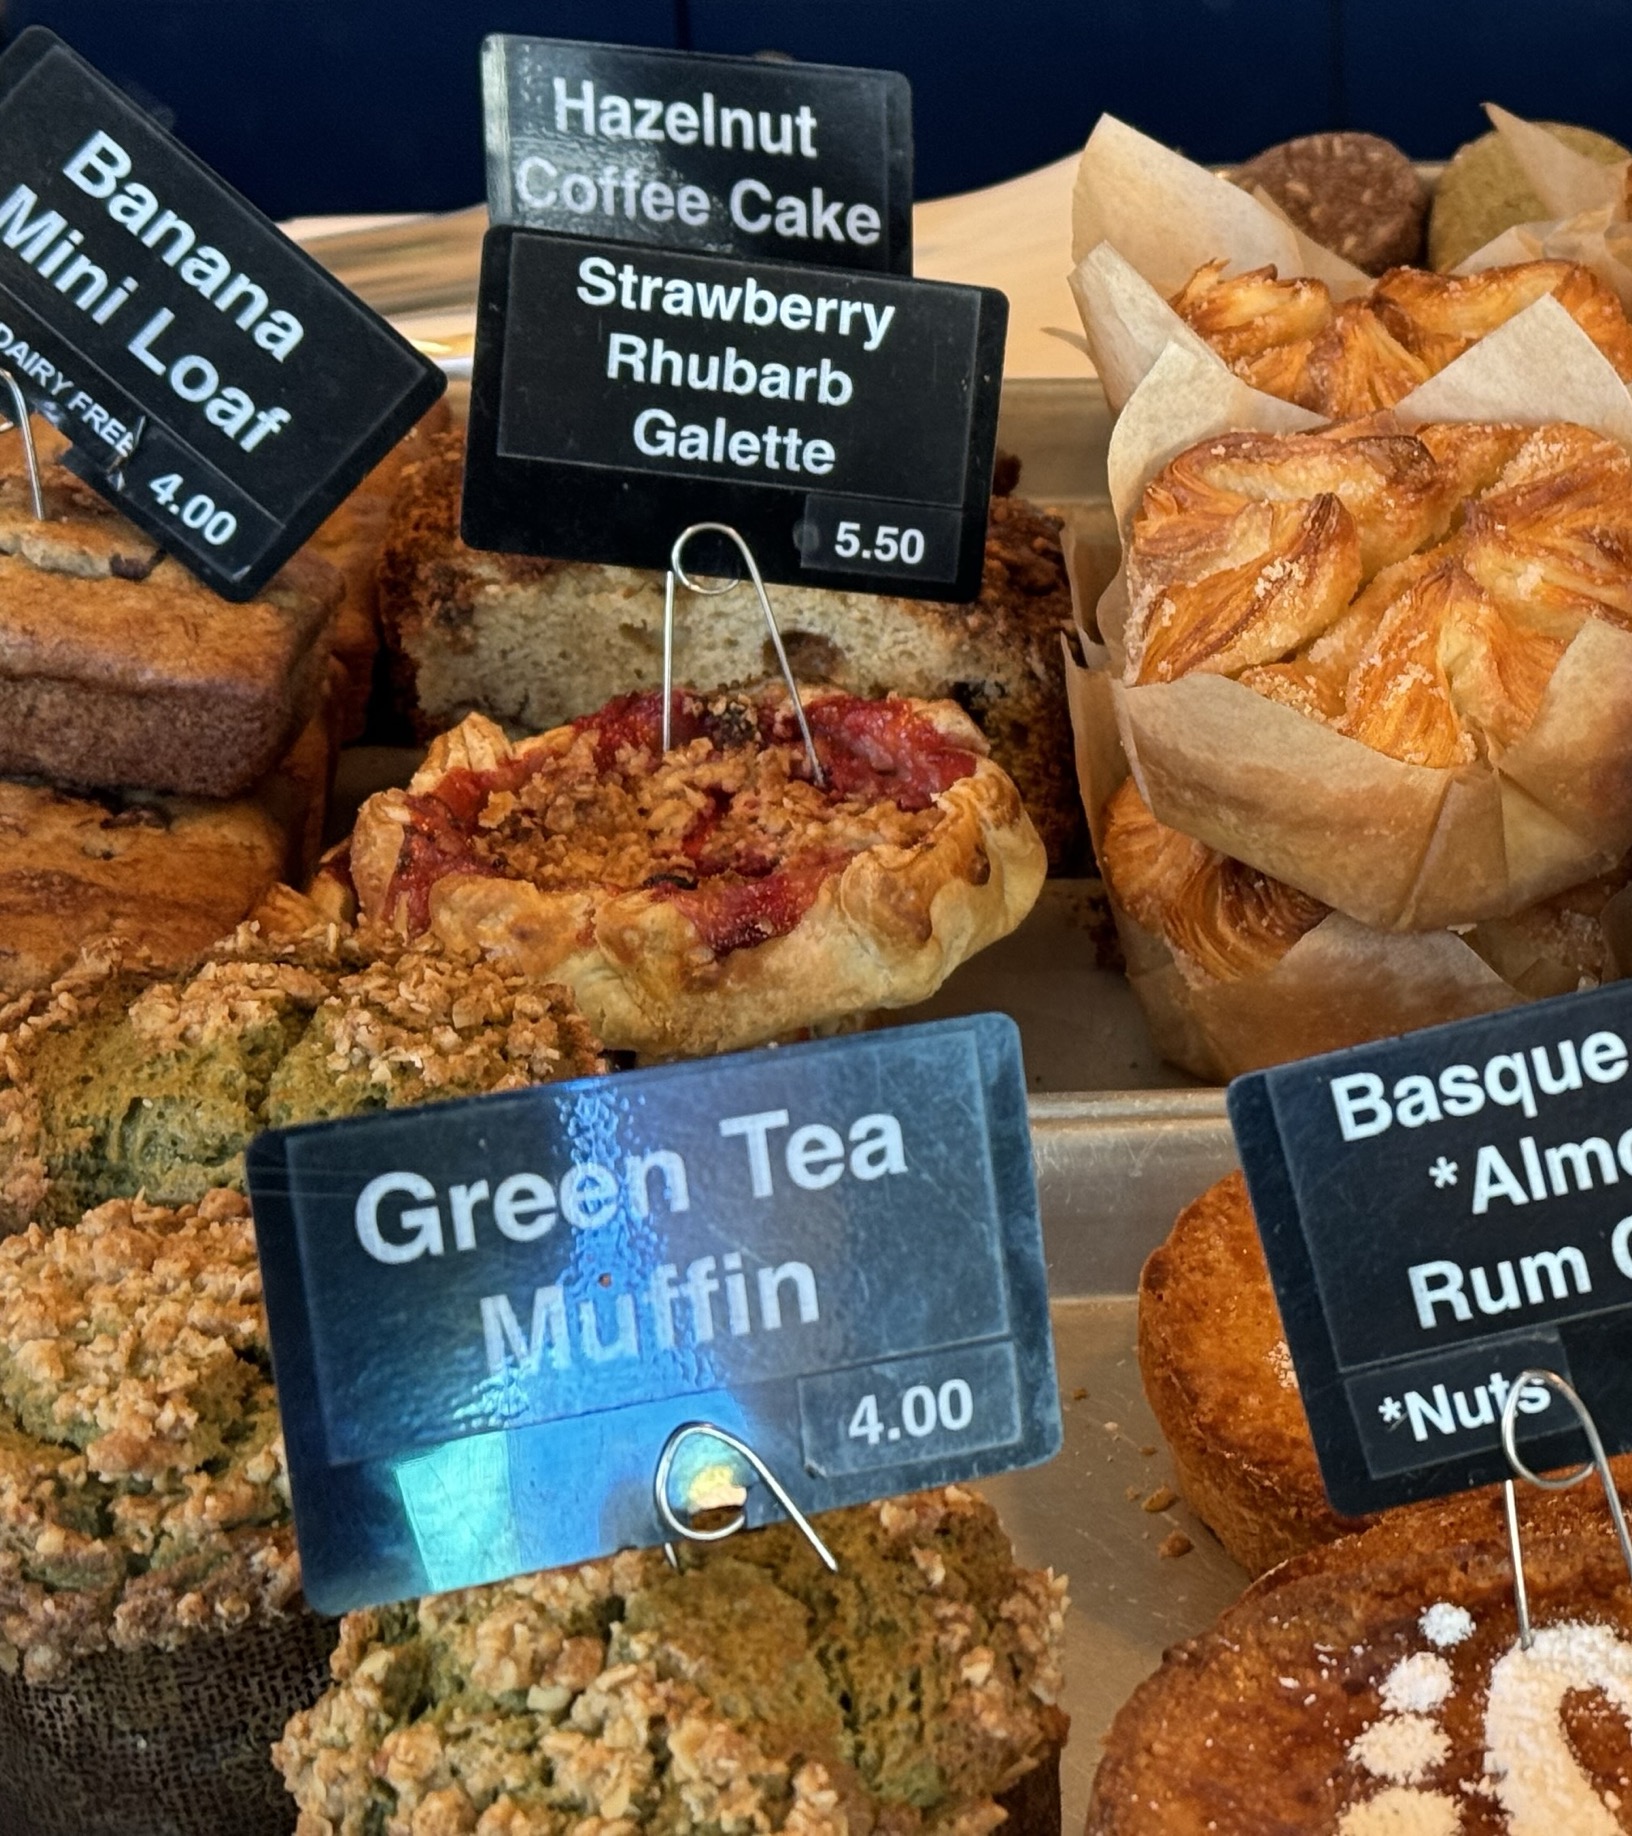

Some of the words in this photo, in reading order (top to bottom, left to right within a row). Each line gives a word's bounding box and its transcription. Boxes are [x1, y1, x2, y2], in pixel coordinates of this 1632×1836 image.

[552, 77, 819, 159] Hazelnut
[516, 155, 711, 226] Coffee
[728, 178, 883, 246] Cake
[62, 130, 304, 363] Banana
[0, 183, 139, 325] Mini
[127, 306, 292, 453] Loaf
[576, 256, 896, 352] Strawberry
[0, 322, 75, 396] DAIRY
[67, 390, 137, 458] FREE
[606, 332, 854, 407] Rhubarb
[632, 408, 837, 475] Galette
[149, 473, 238, 546] 4.00
[833, 522, 926, 565] 5.50
[1330, 1029, 1629, 1142] Basque
[354, 1146, 689, 1264] Green
[720, 1110, 908, 1196] Tea
[478, 1252, 820, 1377] Muffin
[1408, 1256, 1592, 1330] Rum
[847, 1376, 974, 1446] 4.00
